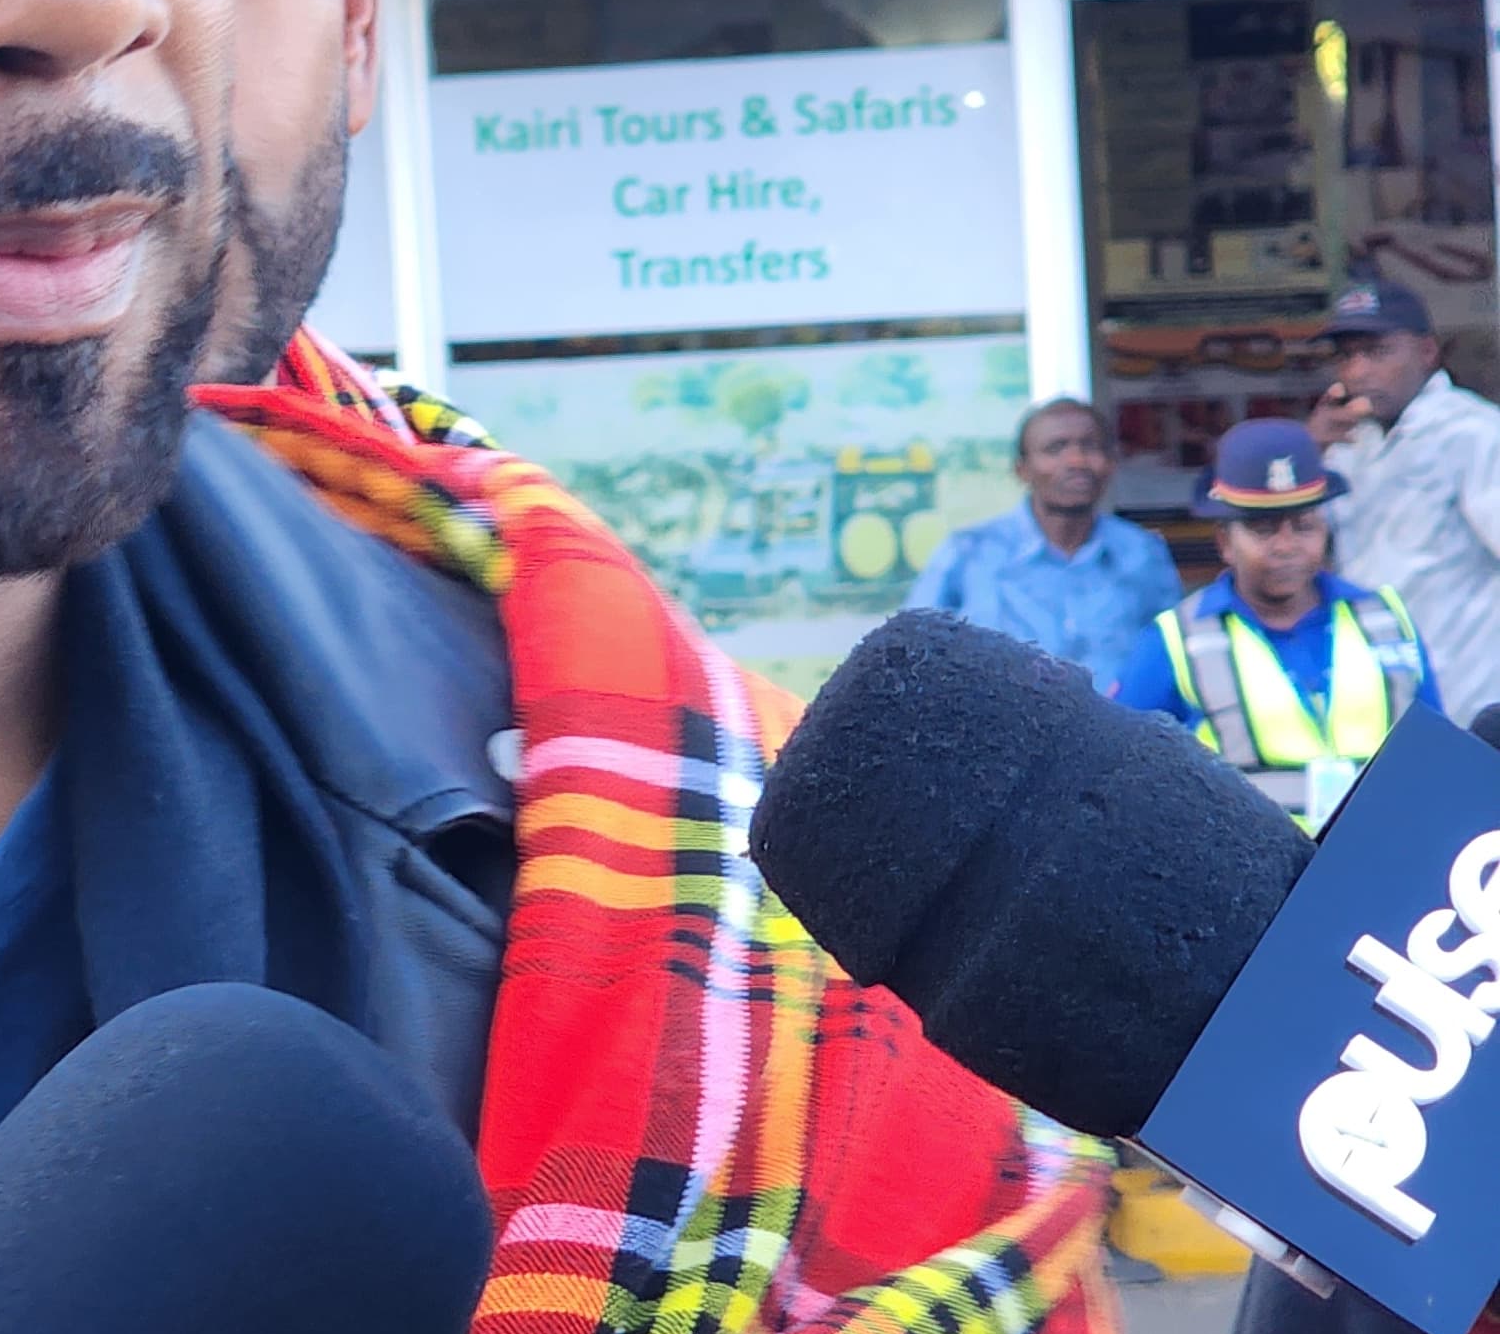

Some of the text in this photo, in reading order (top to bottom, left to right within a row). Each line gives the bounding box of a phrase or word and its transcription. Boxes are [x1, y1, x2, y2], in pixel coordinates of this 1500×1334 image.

[474, 84, 959, 153] Kairi Tours & Safaris
[612, 168, 824, 218] Car Hire,
[612, 238, 832, 290] Transfers
